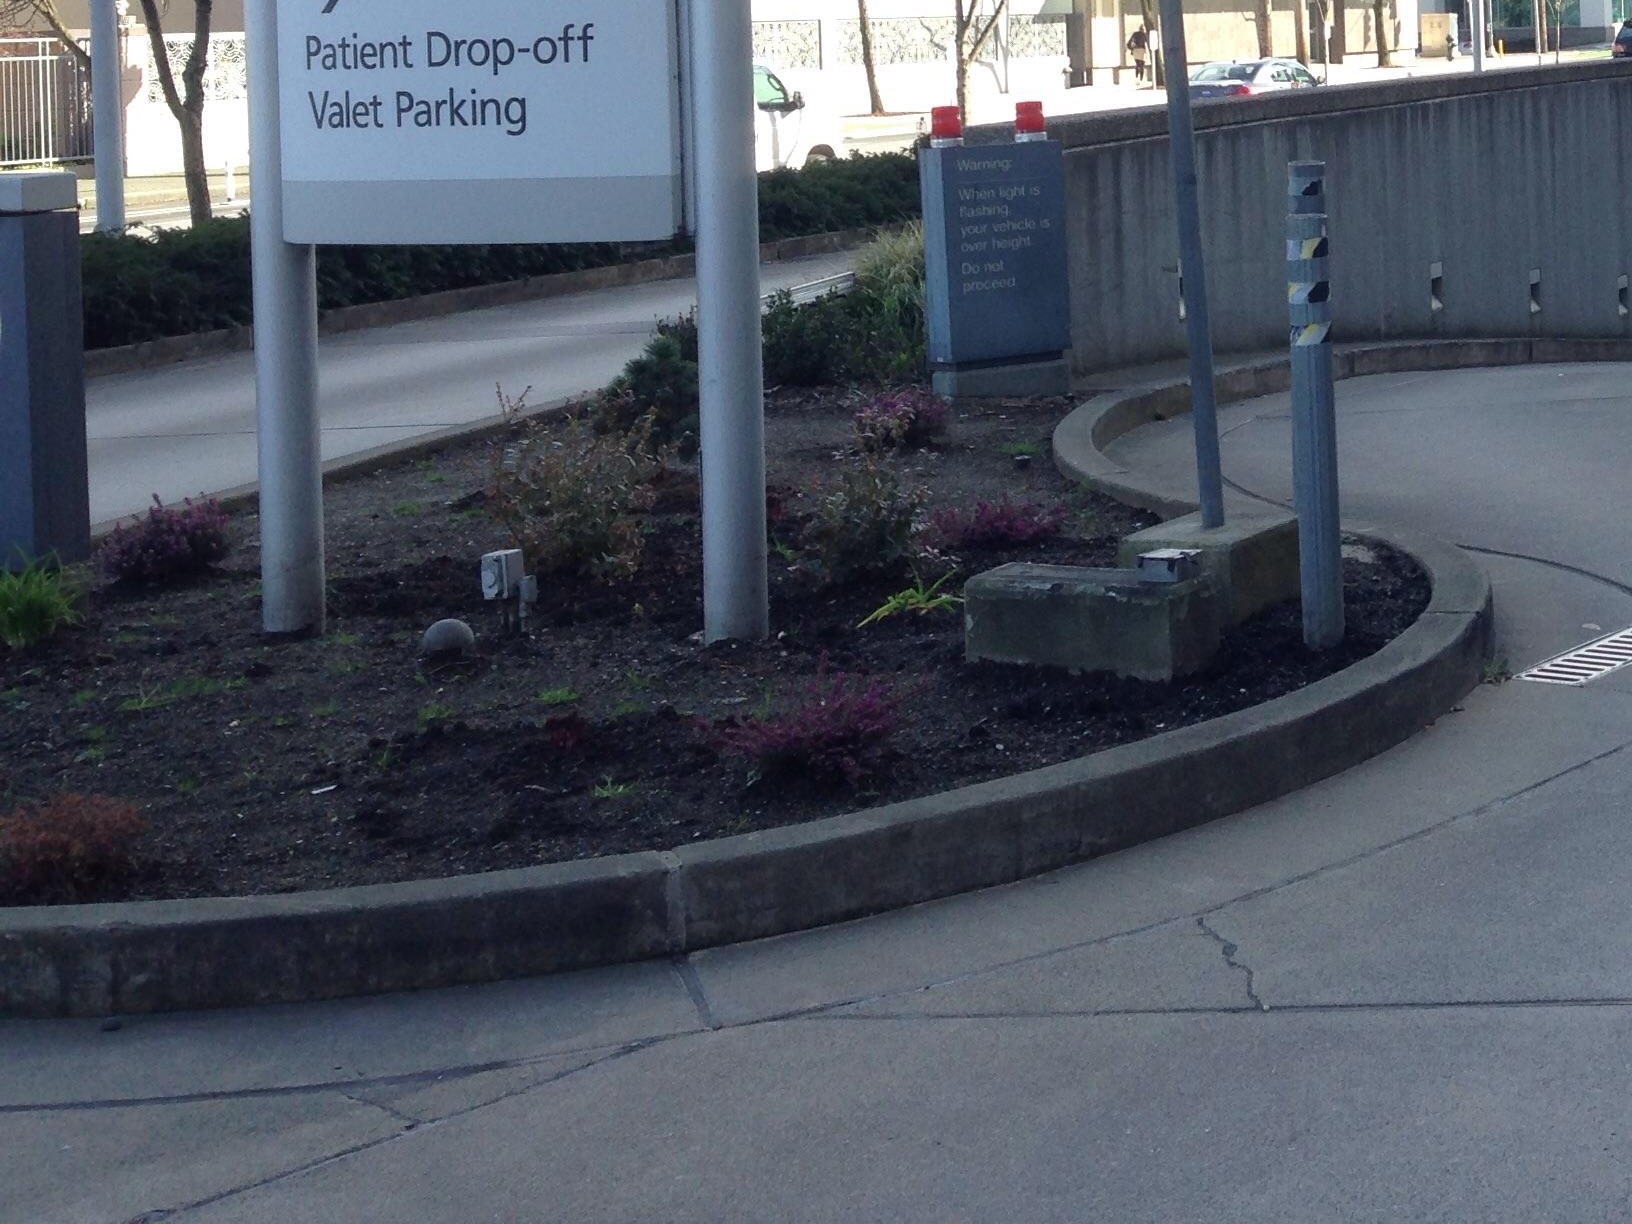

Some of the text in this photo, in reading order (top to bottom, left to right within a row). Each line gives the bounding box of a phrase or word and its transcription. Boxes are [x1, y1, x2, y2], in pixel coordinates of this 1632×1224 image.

[305, 23, 595, 76] Patient Drop-off
[308, 87, 527, 136] Valet Parking
[958, 188, 995, 201] When
[1029, 186, 1041, 196] is
[960, 217, 1051, 239] your vehicle is
[960, 240, 988, 253] over
[961, 259, 1004, 275] Do not
